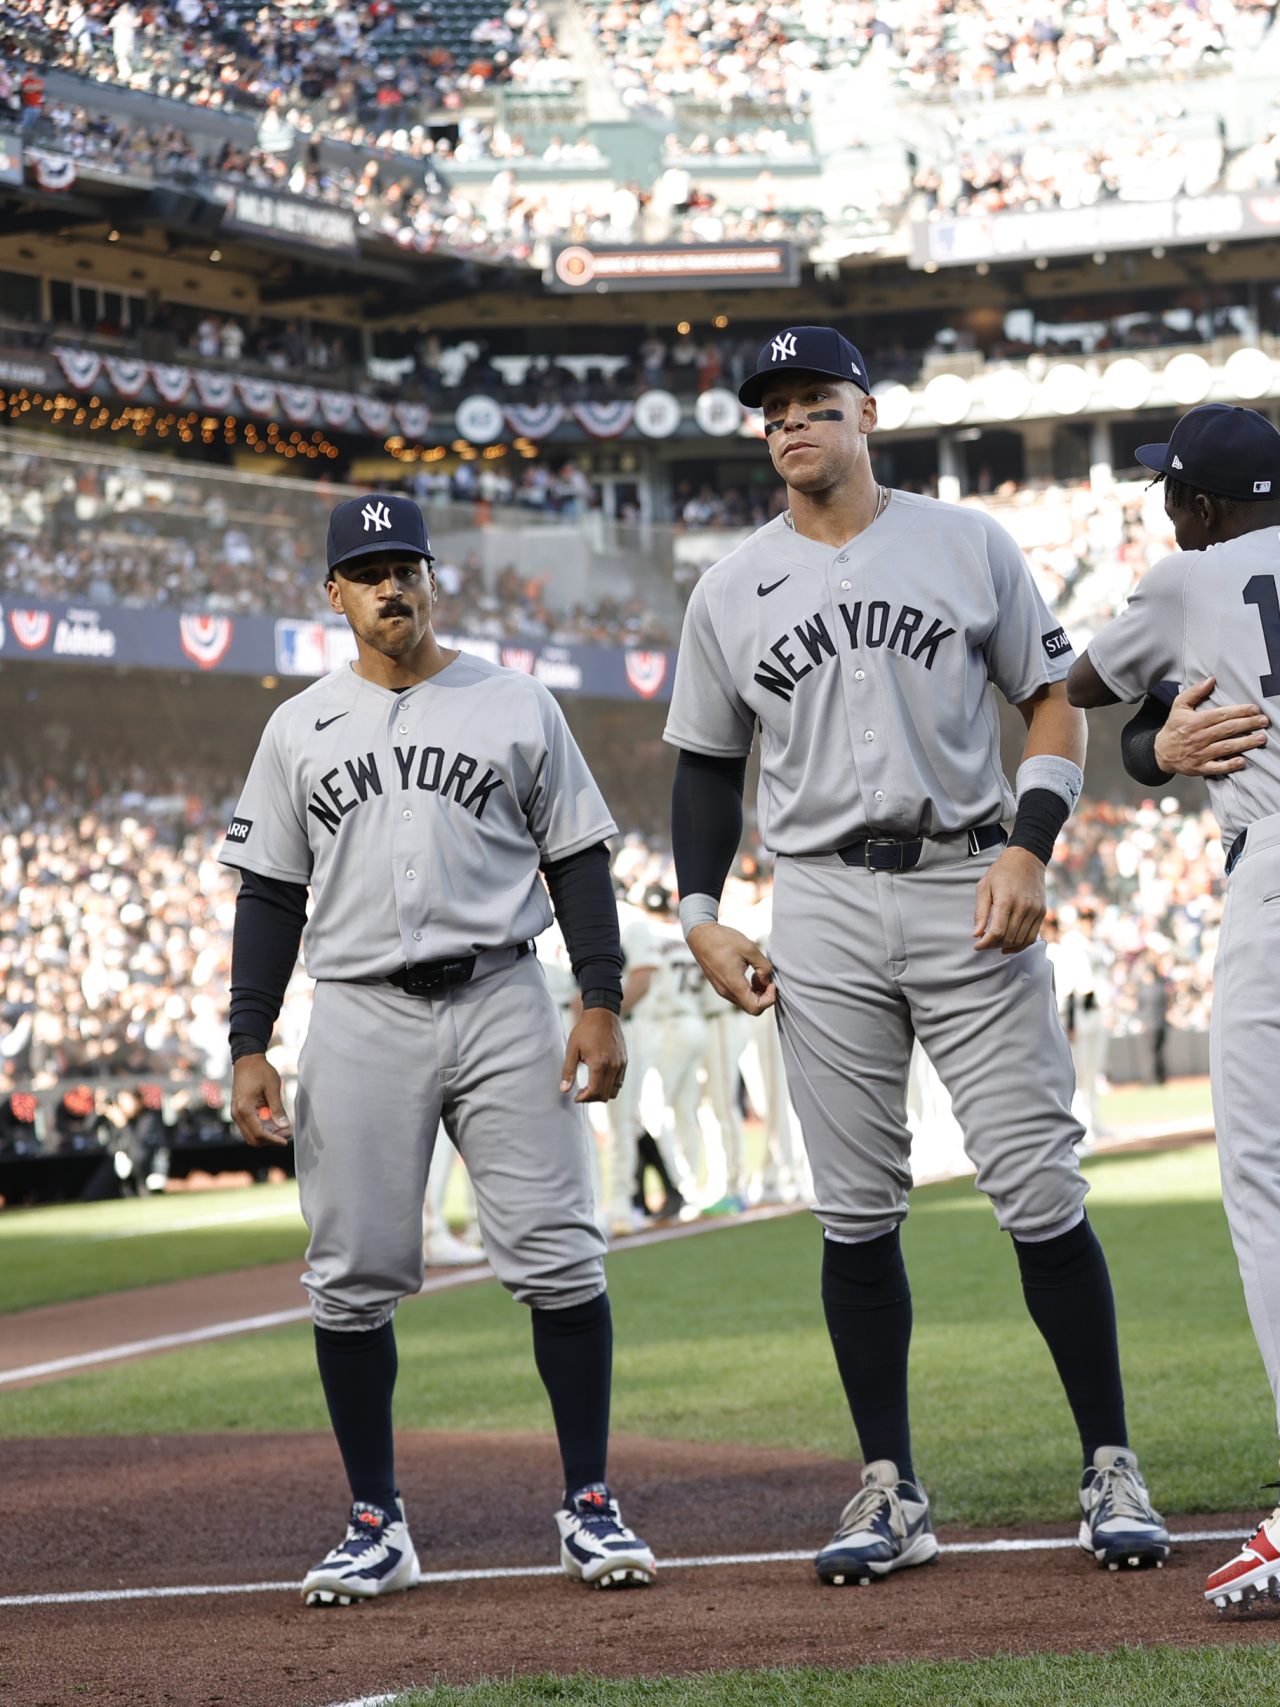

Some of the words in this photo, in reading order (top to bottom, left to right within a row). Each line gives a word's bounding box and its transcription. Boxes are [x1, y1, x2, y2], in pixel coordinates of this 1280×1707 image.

[771, 332, 797, 362] NY
[361, 501, 392, 532] NY
[753, 613, 838, 703] NEW
[839, 601, 957, 671] YORK
[1045, 632, 1069, 653] STA
[307, 752, 383, 836] NEW
[394, 745, 504, 819] YORK
